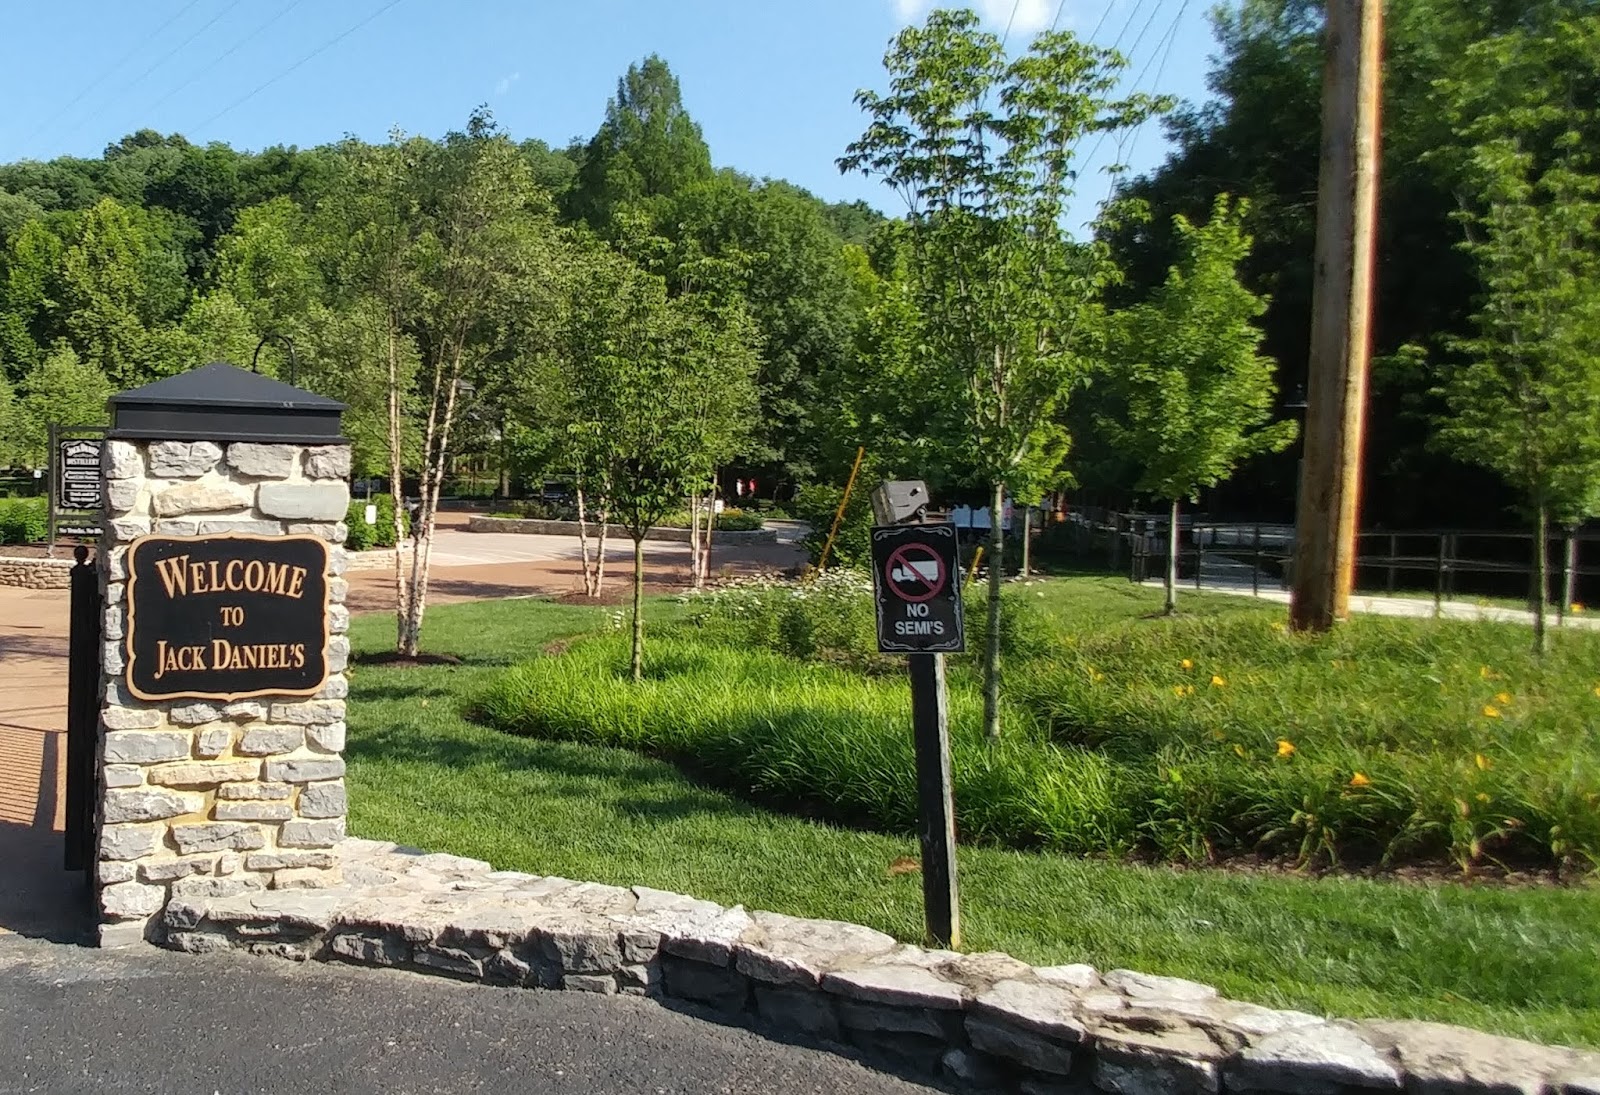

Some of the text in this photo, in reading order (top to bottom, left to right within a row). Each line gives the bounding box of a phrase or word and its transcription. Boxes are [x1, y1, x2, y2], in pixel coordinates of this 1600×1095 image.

[155, 554, 307, 599] WELCOME
[220, 606, 244, 626] TO
[906, 603, 929, 617] NO
[895, 620, 944, 635] SEMI'S
[154, 639, 305, 680] JACK DANIEL'S
